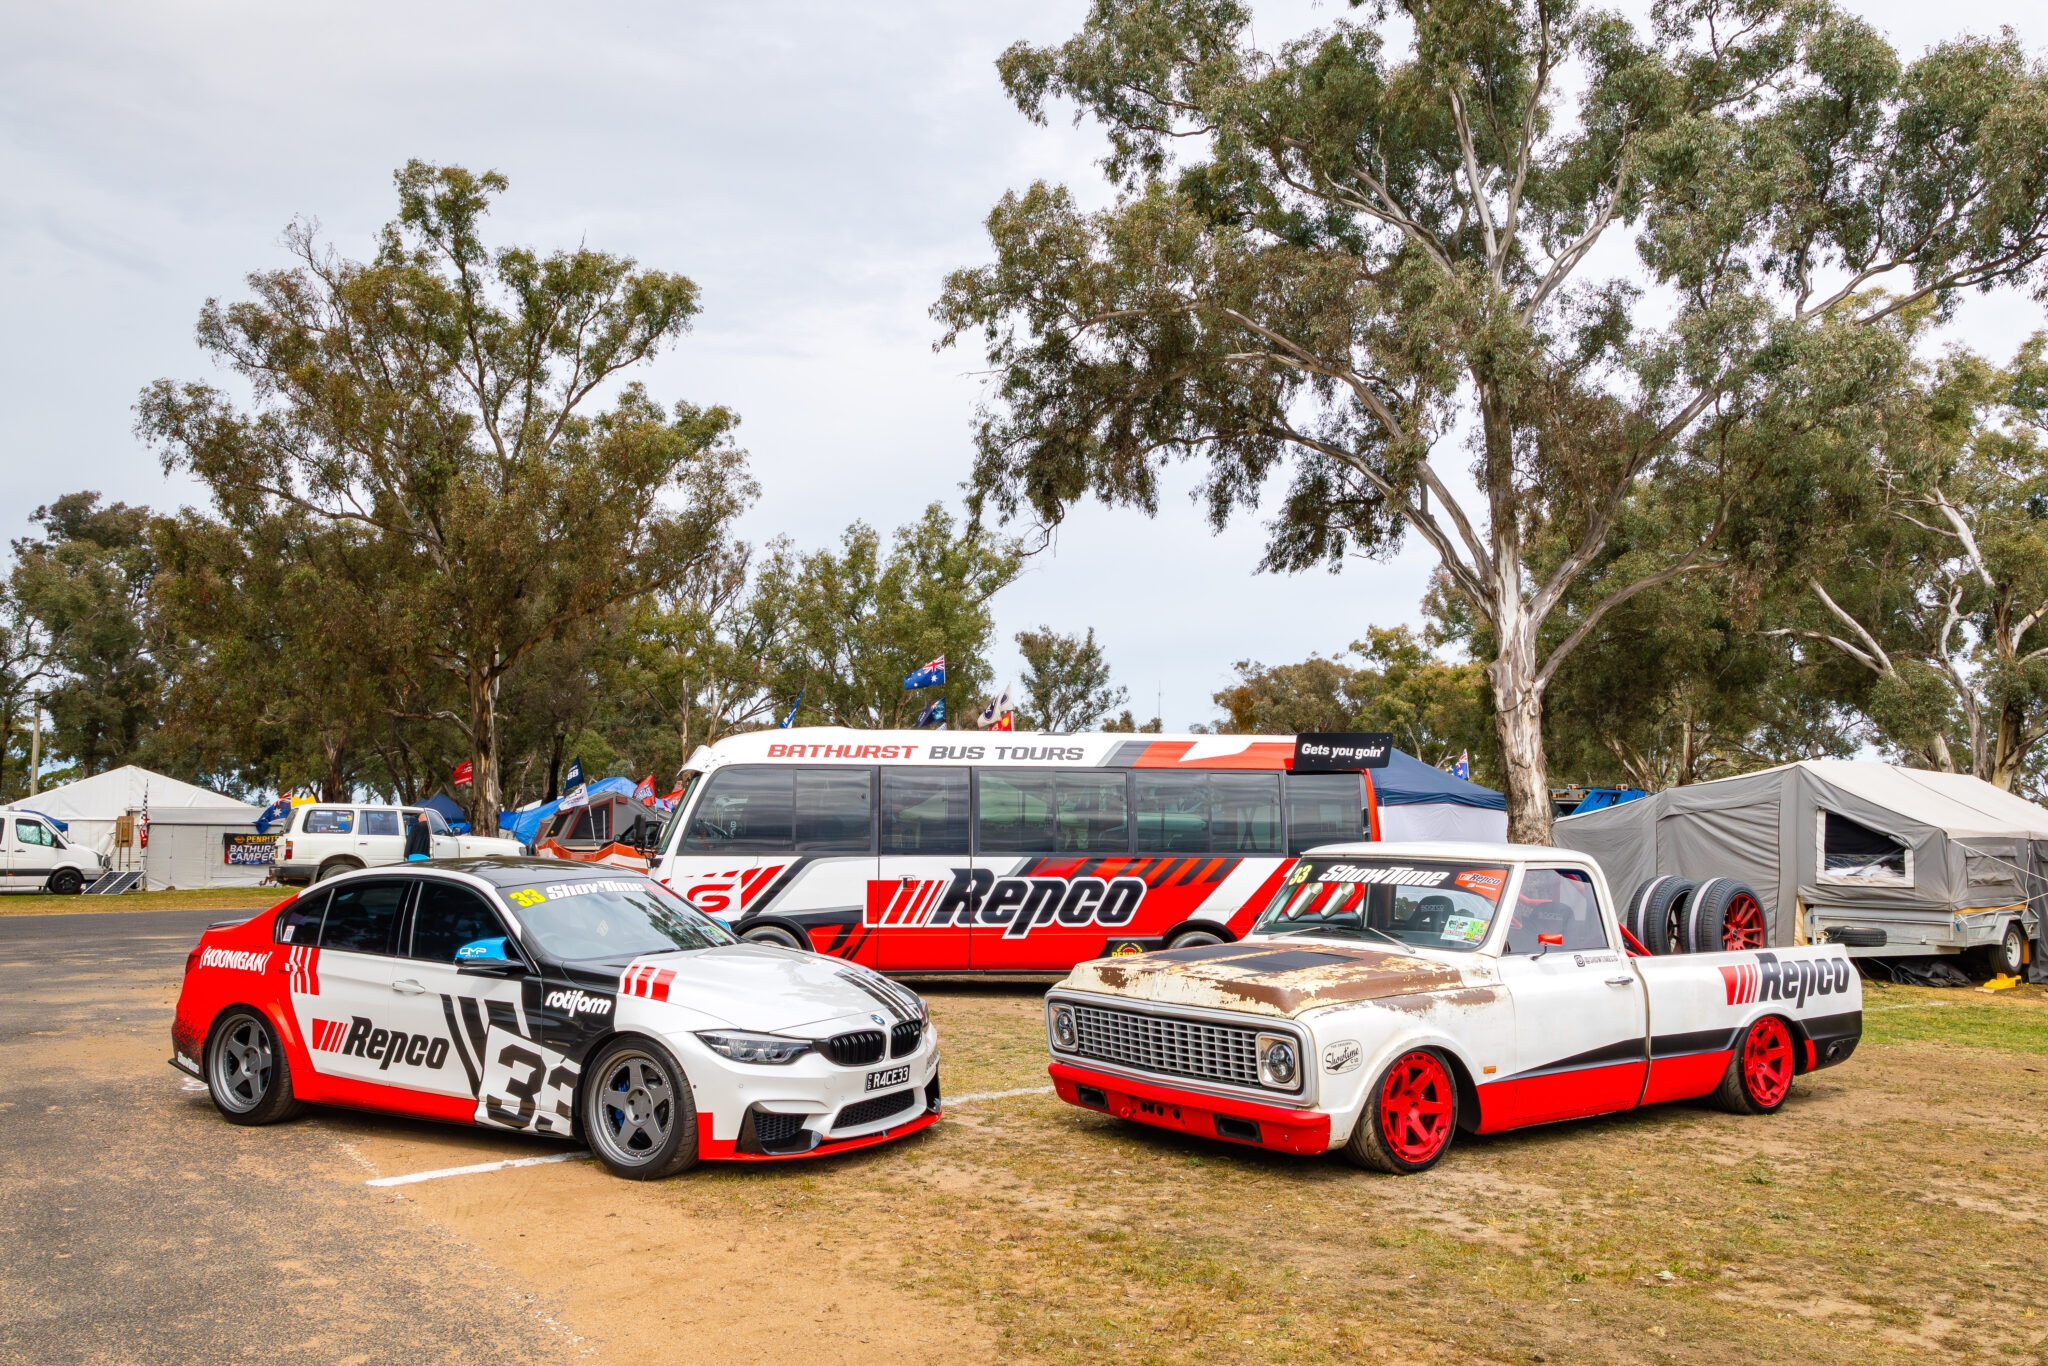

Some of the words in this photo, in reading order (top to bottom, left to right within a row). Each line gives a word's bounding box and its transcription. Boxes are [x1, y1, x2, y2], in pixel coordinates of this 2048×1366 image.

[767, 744, 919, 759] BATHURST
[928, 745, 985, 760] BUS
[995, 746, 1085, 761] TOURS
[1301, 743, 1330, 755] Gets
[1331, 746, 1354, 759] you
[1289, 865, 1313, 886] 33
[1317, 864, 1450, 888] ShowTime
[1469, 873, 1502, 885] Repco
[509, 888, 546, 907] 33
[927, 867, 1148, 939] Repco
[1755, 952, 1850, 1009] Repco
[544, 989, 612, 1018] rotiform
[342, 1015, 450, 1071] Repco
[1325, 1046, 1359, 1066] Showtime
[873, 1066, 909, 1089] R4CE33
